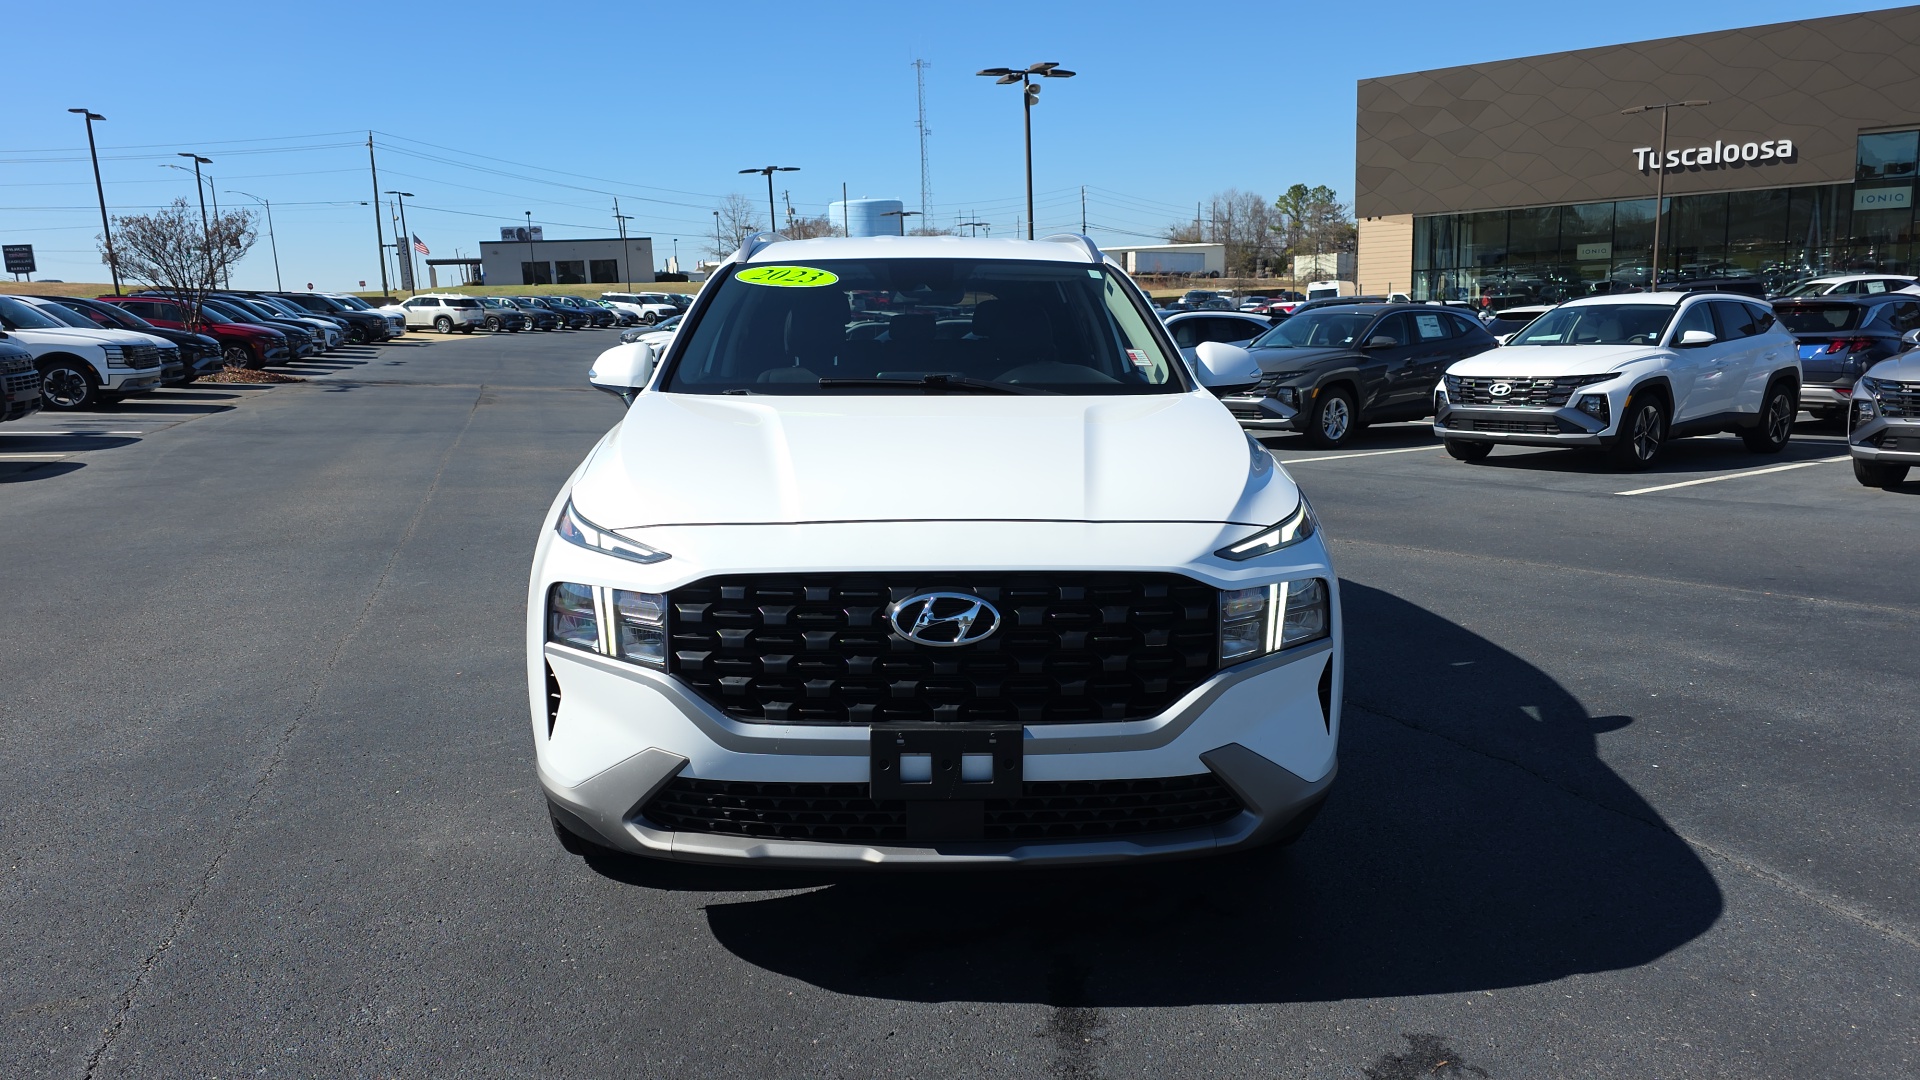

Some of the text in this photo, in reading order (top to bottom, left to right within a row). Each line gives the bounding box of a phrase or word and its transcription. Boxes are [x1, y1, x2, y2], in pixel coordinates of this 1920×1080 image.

[1632, 139, 1793, 171] Tuscaloosa
[1860, 193, 1905, 204] IONIQ
[749, 269, 825, 283] 2023
